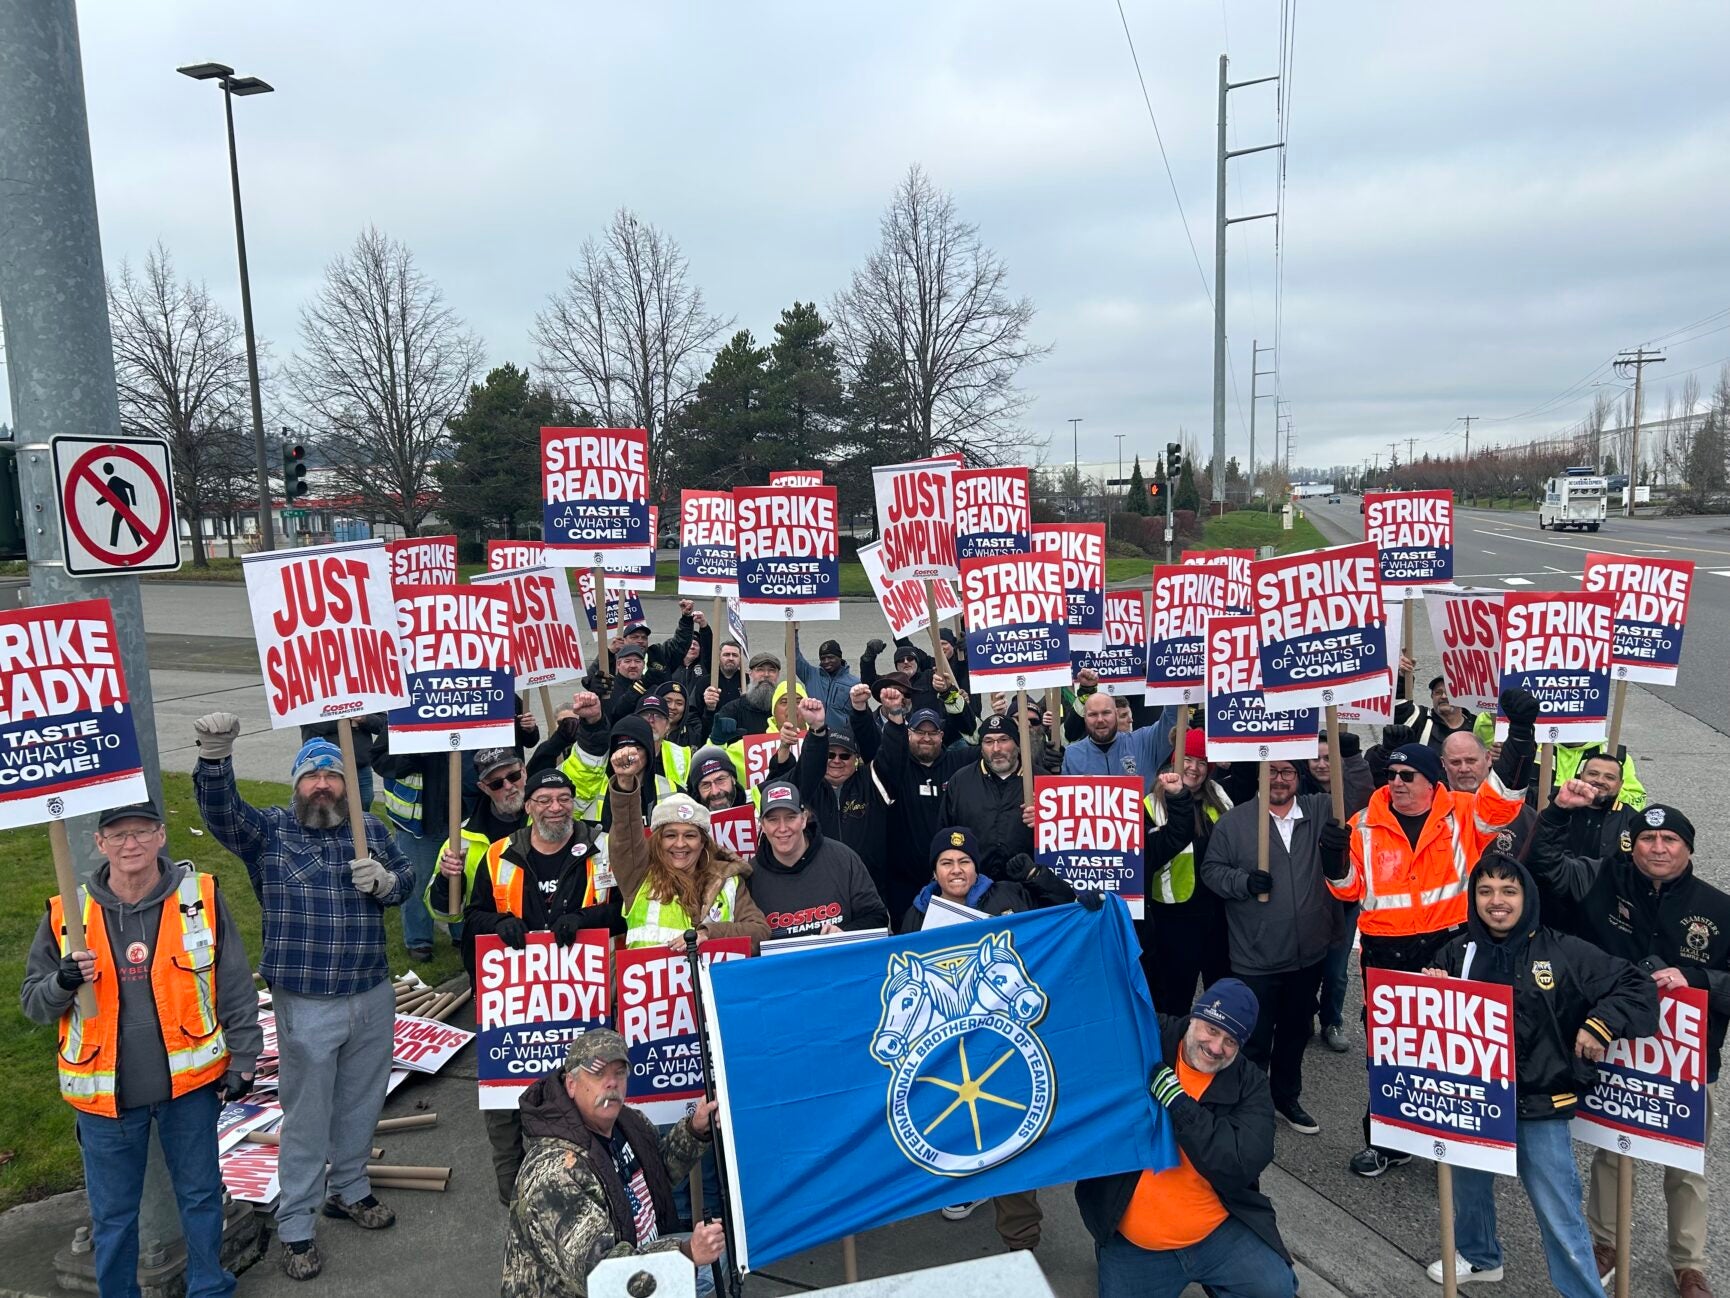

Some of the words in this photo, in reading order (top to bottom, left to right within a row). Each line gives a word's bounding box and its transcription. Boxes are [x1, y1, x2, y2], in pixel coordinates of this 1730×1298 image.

[546, 436, 645, 473] STRIKE
[547, 469, 645, 506] READY!
[888, 471, 946, 523] JUST
[955, 476, 1026, 508] STRIKE
[554, 518, 570, 528] OF
[574, 518, 623, 528] WHAT'S
[626, 518, 640, 528] TO
[564, 506, 573, 516] A
[576, 506, 630, 516] TASTE
[738, 495, 834, 530] STRIKE
[956, 505, 1027, 538] READY!
[1368, 498, 1450, 527] STRIKE
[568, 529, 627, 539] COME!
[683, 521, 736, 547] READ
[740, 527, 835, 562] READY!
[968, 539, 975, 547] A
[976, 538, 1015, 547] TASTE
[1031, 531, 1102, 563] TRIKE
[1368, 523, 1450, 551] READY!
[395, 543, 455, 575] STRIKE
[687, 557, 699, 565] OF
[704, 549, 736, 558] TAST
[1381, 552, 1389, 560] A
[1391, 551, 1437, 560] TASTE
[1389, 560, 1429, 569] WHAT'S
[1431, 559, 1446, 568] TO
[697, 566, 737, 576] COME
[746, 573, 763, 583] OF
[765, 573, 811, 583] WHAT'S
[814, 573, 830, 583] TO
[756, 563, 765, 573] A
[767, 562, 820, 573] TASTE
[966, 561, 1060, 600] STRIKE
[1384, 568, 1434, 578] COME!
[760, 584, 817, 595] COME!
[1155, 573, 1225, 610] STRIKE
[1257, 557, 1377, 610] STRIKE
[1586, 563, 1689, 602] STRIKE
[272, 556, 373, 638] JUST
[511, 575, 559, 624] UST
[1081, 605, 1095, 615] TO
[396, 594, 509, 636] STRIKE
[967, 593, 1064, 633] READY!
[1260, 593, 1380, 648] READY!
[1507, 601, 1612, 640] STRIKE
[1614, 592, 1684, 631] ADY!
[0, 619, 115, 673] RIKE
[976, 643, 992, 654] OF
[995, 640, 1042, 653] WHAT'S
[1044, 638, 1060, 649] TO
[986, 632, 994, 642] A
[997, 627, 1050, 641] TASTE
[1283, 644, 1294, 656] A
[1298, 633, 1363, 651] TASTE
[1613, 635, 1652, 648] HAT'S
[1655, 639, 1672, 650] TO
[401, 632, 510, 675] READY!
[990, 650, 1048, 664] COME!
[1092, 658, 1127, 667] WHAT'S
[1129, 657, 1142, 665] TO
[1093, 649, 1133, 658] TASTE
[1155, 656, 1168, 666] OF
[1165, 644, 1172, 653] A
[1175, 643, 1204, 654] TAST
[1272, 657, 1292, 670] OF
[1295, 648, 1353, 667] WHAT'S
[1357, 643, 1376, 657] TO
[1504, 635, 1610, 676] READY!
[1613, 646, 1657, 658] OME!
[266, 627, 404, 716] SAMPLING
[1165, 666, 1204, 677] COME
[1289, 658, 1361, 680] COME!
[1442, 649, 1500, 698] SAMPL
[1521, 676, 1531, 687] A
[1535, 676, 1590, 687] TASTE
[413, 679, 424, 690] A
[428, 676, 493, 690] TASTE
[425, 690, 482, 704] WHAT'S
[486, 689, 504, 701] TO
[1532, 689, 1580, 700] WHAT'S
[1582, 689, 1600, 699] TO
[0, 667, 124, 728] ADY!
[323, 700, 364, 713] COSTCO
[418, 702, 488, 718] COME!
[1229, 698, 1238, 708] A
[1540, 701, 1584, 712] OME!
[1217, 710, 1235, 720] OF
[1232, 719, 1295, 732] COME!
[3, 719, 100, 747] TASTE
[2, 739, 88, 767] WHAT'S
[97, 734, 121, 751] TO
[0, 753, 101, 785] COME!
[1038, 785, 1140, 821] STRIKE
[1038, 818, 1140, 856] READY!
[1055, 856, 1065, 866] A
[1068, 856, 1124, 867] TASTE
[1065, 868, 1115, 878] WHAT'S
[1118, 868, 1134, 878] TO
[766, 902, 842, 929] COSTCO
[786, 916, 843, 934] TEAMSTERS
[1680, 915, 1720, 936] TEAMSTERS
[1680, 945, 1700, 956] LOCAL
[481, 942, 605, 990] STRIKE
[481, 983, 606, 1033] READY!
[1372, 984, 1509, 1045] STRIKE
[502, 1032, 514, 1045] A
[917, 1016, 1014, 1058] BROTHERHOOD
[1015, 1032, 1032, 1049] OF
[489, 1047, 510, 1059] OF
[647, 1047, 658, 1060] A
[1372, 1026, 1509, 1090] READY!
[1605, 1037, 1700, 1091] ADY!
[507, 1060, 565, 1074] COM
[634, 1063, 655, 1076] OF
[1018, 1050, 1047, 1139] TEAMSTERS
[1395, 1071, 1405, 1085] A
[1409, 1073, 1486, 1101] TASTE
[1597, 1068, 1675, 1100] TASTE
[893, 1060, 939, 1163] INTERNATIONAL
[1382, 1083, 1403, 1099] OF
[1406, 1088, 1477, 1116] WHAT'S
[1479, 1101, 1501, 1119] TO
[1584, 1094, 1669, 1129] COME!
[1594, 1084, 1661, 1112] WHAT'S
[1665, 1099, 1691, 1118] TO
[1400, 1102, 1481, 1131] COME!
